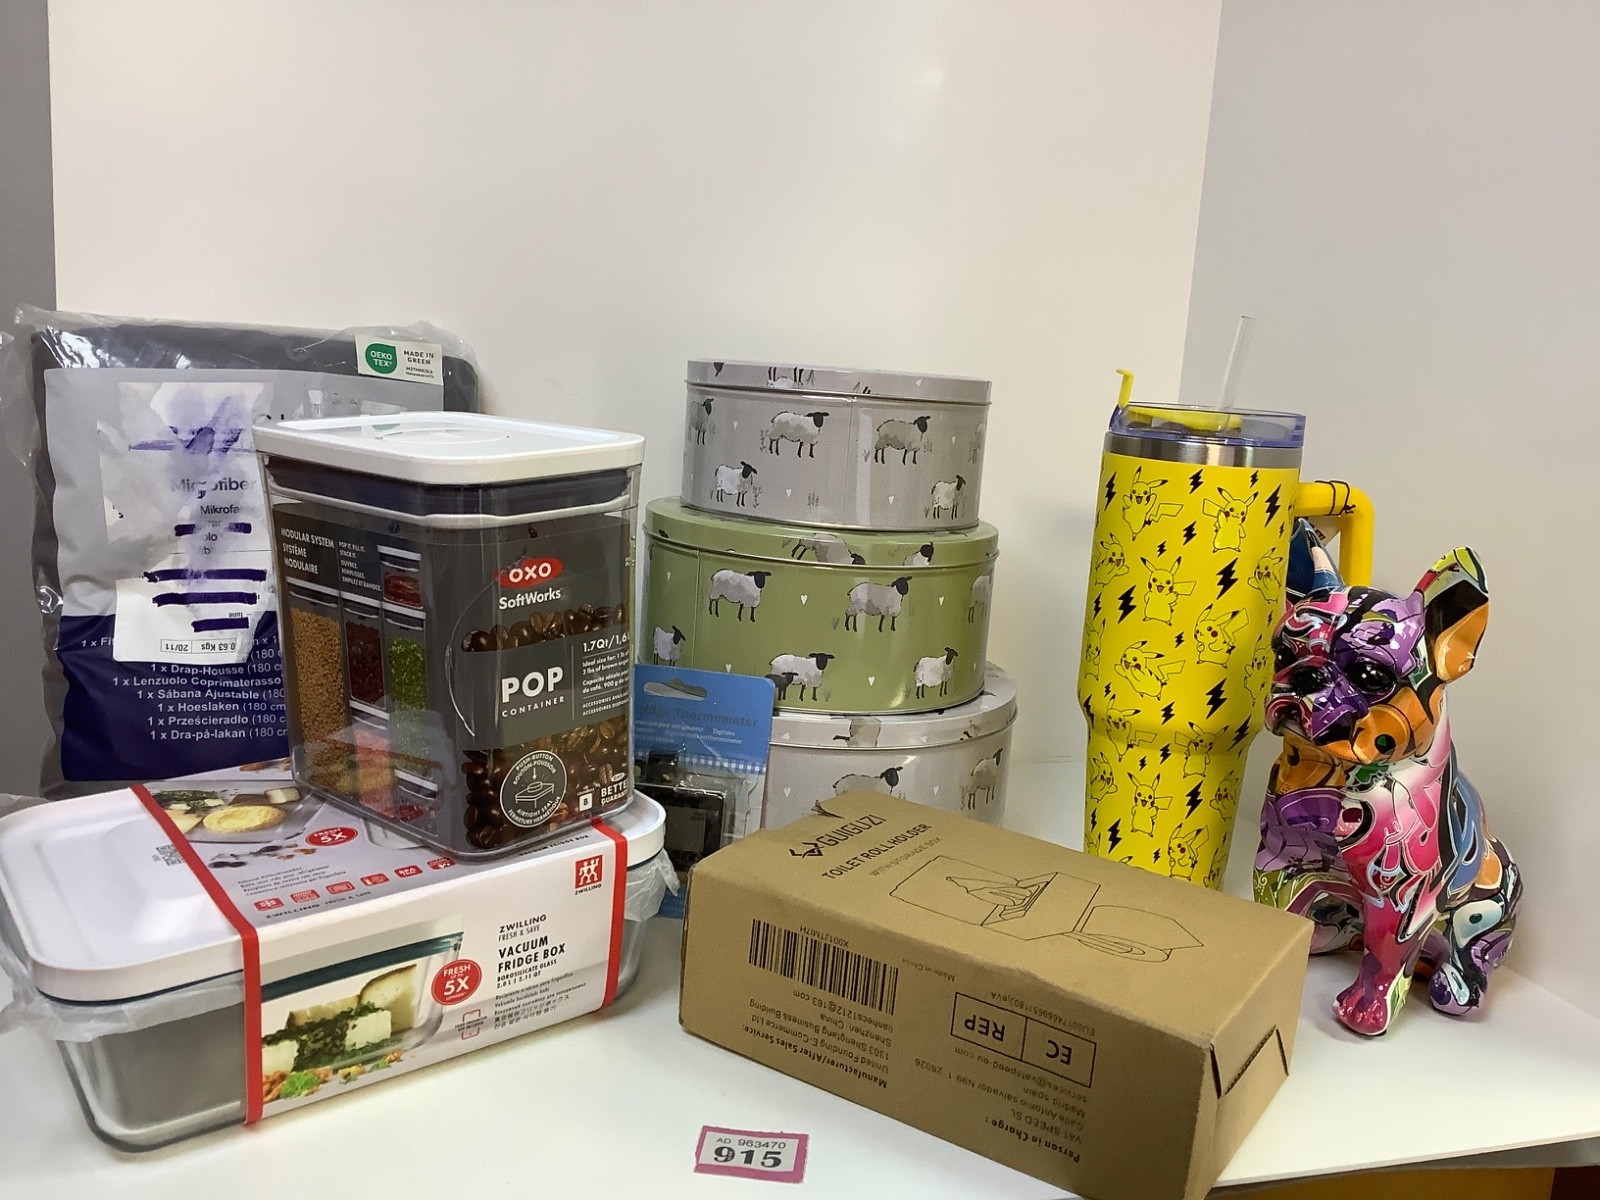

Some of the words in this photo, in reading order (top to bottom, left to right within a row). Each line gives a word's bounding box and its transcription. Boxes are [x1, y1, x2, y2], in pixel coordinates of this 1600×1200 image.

[370, 350, 393, 360] OEKO
[407, 357, 431, 365] GREEN
[281, 527, 310, 543] MODULAR
[311, 534, 335, 548] SYSTEM
[282, 543, 307, 557] SYSTÈME
[284, 557, 319, 574] MODULAIRE
[508, 562, 552, 583] OXO
[499, 587, 562, 610] SoftWorks
[165, 643, 188, 651] 20/11
[201, 642, 216, 651] Kgs
[171, 664, 244, 676] Drap-Housse
[247, 663, 271, 675] (180
[133, 676, 188, 686] Lenzuolo
[191, 677, 282, 687] Coprimaterasso
[501, 666, 564, 703] POP
[157, 689, 201, 699] Sábana
[205, 689, 260, 700] Ajustable
[178, 702, 239, 712] Hoeslaken
[242, 702, 267, 712] (180
[502, 695, 565, 718] CONTAINER
[168, 714, 249, 726] Prześcieradło
[252, 714, 276, 725] (180
[171, 729, 246, 741] Dra-på-lakan
[249, 727, 274, 738] (180
[515, 753, 554, 771] PUSH-BUTTON
[601, 780, 628, 798] BETTE
[541, 800, 554, 814] SEAL
[319, 832, 348, 844] 5X
[816, 814, 887, 846] GUIGUZI
[822, 856, 866, 879] TOILET
[862, 840, 894, 860] ROLL
[890, 824, 933, 845] HOLDER
[574, 883, 602, 895] ZWILLING
[498, 930, 518, 942] FRESH
[526, 924, 541, 935] SAVE
[499, 914, 547, 934] ZWILLING
[498, 935, 548, 959] VACUUM
[498, 952, 540, 974] FRIDGE
[542, 943, 566, 960] BOX
[444, 964, 472, 977] FRESH
[497, 964, 538, 982] BOROSILICATE
[540, 959, 558, 969] GLASS
[443, 976, 470, 996] 5X
[750, 998, 782, 1020] Building
[782, 1012, 820, 1034] Business
[820, 1012, 845, 1029] China
[964, 1014, 1006, 1042] REP
[742, 1024, 776, 1044] Service:
[765, 1018, 819, 1047] E-Commerce
[821, 1027, 868, 1052] Shengtang
[776, 1037, 798, 1053] Sales
[820, 1040, 860, 1062] Founding
[868, 1046, 889, 1060] 1303
[1046, 1039, 1073, 1066] EC
[800, 1046, 888, 1088] Manufacturer/After
[860, 1054, 889, 1074] United
[1010, 1108, 1023, 1122] SL
[1019, 1100, 1058, 1122] Antonio
[991, 1118, 1030, 1142] Charge
[1024, 1114, 1061, 1136] SPEED
[738, 1138, 787, 1150] 963470
[1062, 1130, 1082, 1146] VAT
[713, 1146, 782, 1168] 915
[1044, 1138, 1080, 1164] Person
